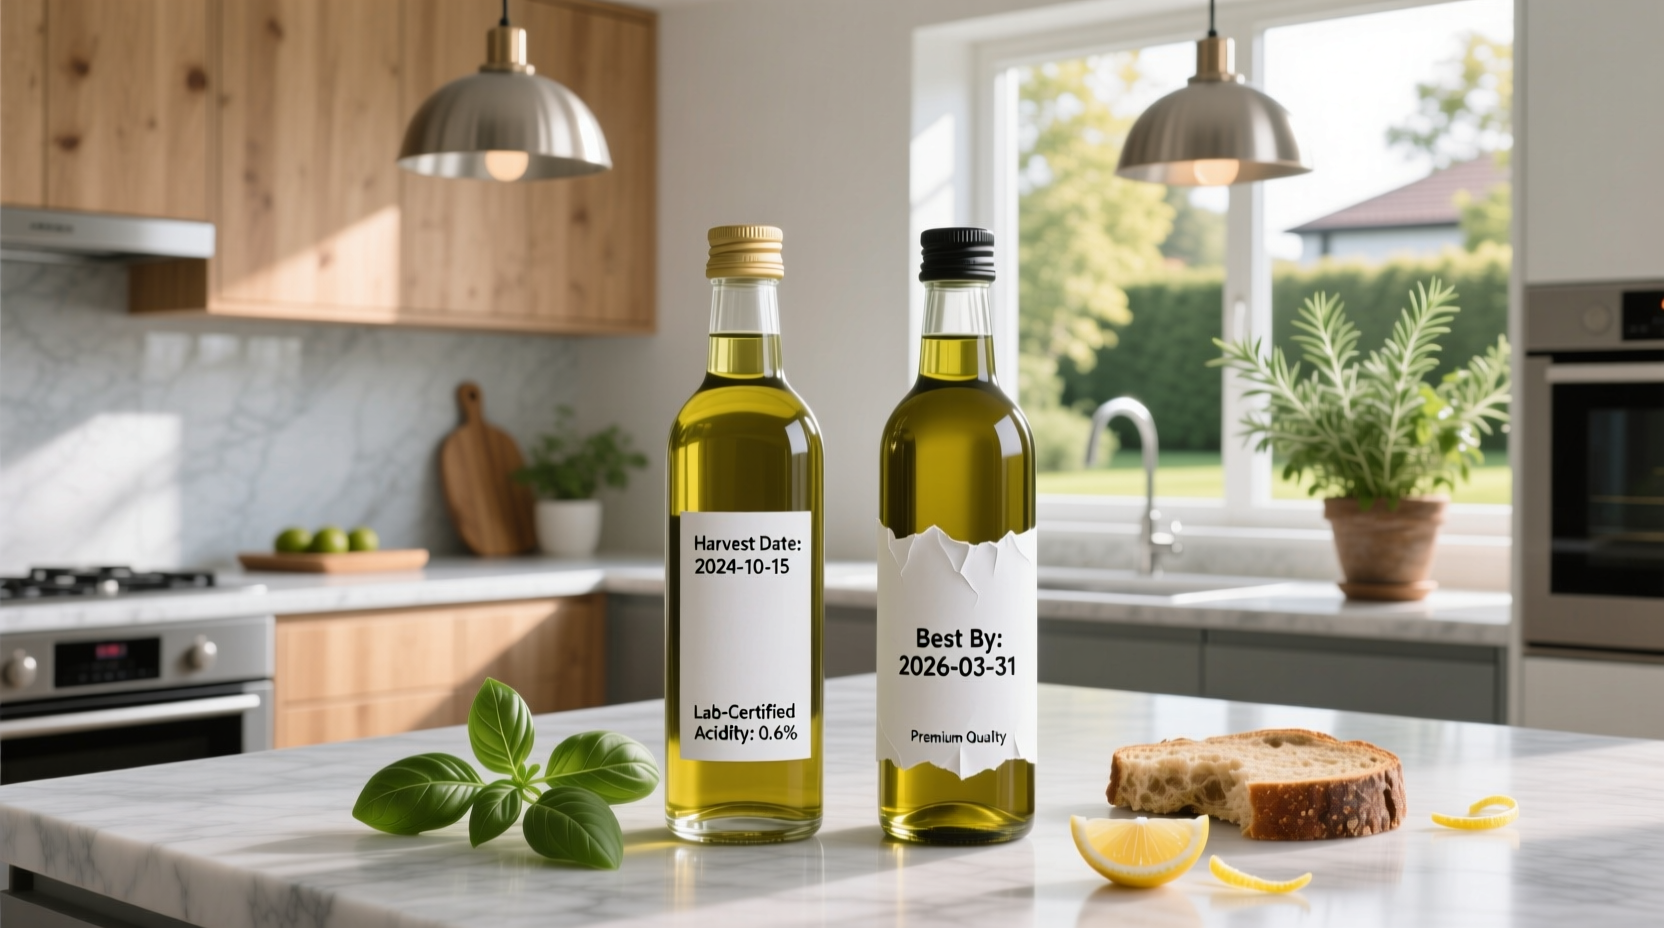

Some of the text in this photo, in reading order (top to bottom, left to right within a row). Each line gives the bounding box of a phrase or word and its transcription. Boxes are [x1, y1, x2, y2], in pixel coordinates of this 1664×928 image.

[694, 534, 802, 552] Harvest Date:
[694, 558, 790, 575] 2024-10-15
[916, 627, 1003, 653] Best By:
[899, 655, 1016, 677] 2026-03-31
[694, 703, 796, 720] Lab-Certified
[694, 725, 798, 745] Acidity: 0.6%
[911, 729, 963, 744] Premium
